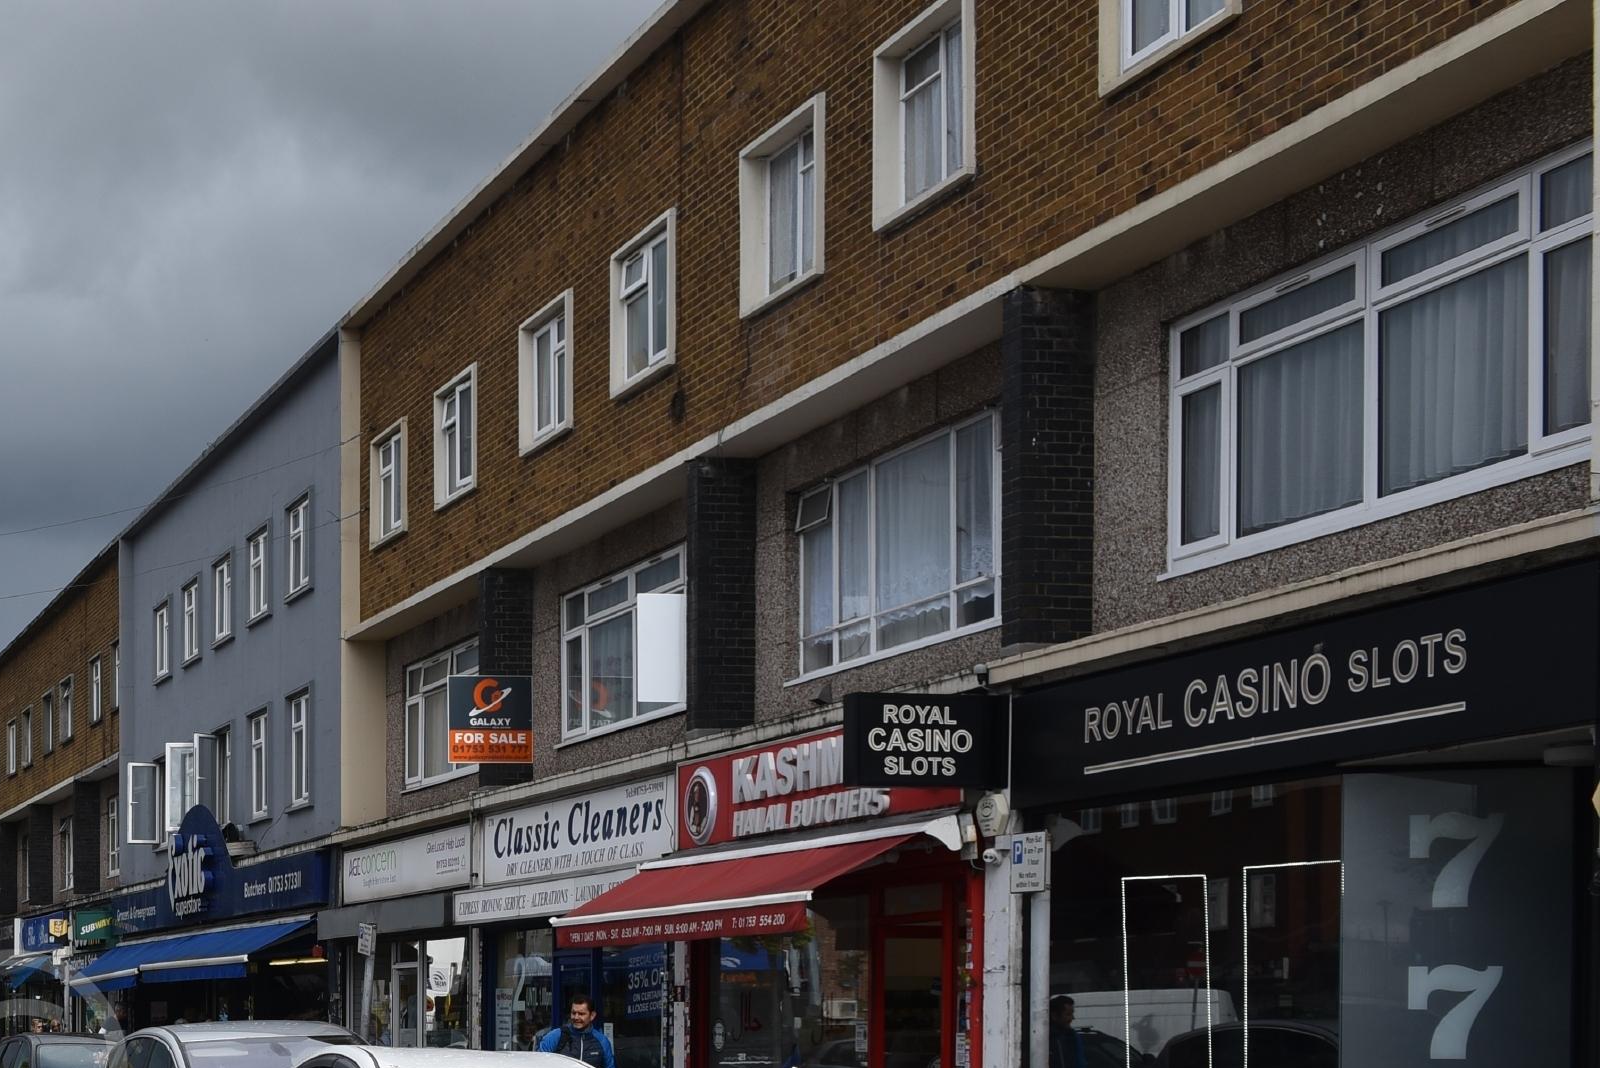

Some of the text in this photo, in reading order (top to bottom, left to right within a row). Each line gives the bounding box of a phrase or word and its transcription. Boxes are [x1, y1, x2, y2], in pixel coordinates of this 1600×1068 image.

[1084, 629, 1468, 744] ROYAL CASINO SLOTS
[469, 717, 511, 726] GALAXY
[882, 704, 958, 725] ROYAL
[452, 744, 485, 753] 01753
[454, 732, 527, 744] FOR SALE
[867, 727, 973, 753] CASINO
[732, 735, 844, 804] KASHM
[883, 755, 957, 776] SLOTS
[732, 787, 891, 838] HALAL BUTCHERS
[493, 798, 664, 859] Classic Cleaners
[505, 842, 644, 877] DRY CLEANERS WITH A TOUCH OF CLASS
[1408, 811, 1506, 908] 7
[244, 880, 266, 898] Butchers
[268, 875, 284, 893] 01753
[175, 897, 202, 920] superstore
[458, 899, 480, 916] EXPRESS
[504, 894, 526, 911] SERVICE
[531, 888, 569, 907] ALTERATIONS
[80, 917, 112, 935] SUBWAY
[772, 913, 785, 925] 200
[628, 970, 649, 990] 35%
[1407, 964, 1504, 1059] 7
